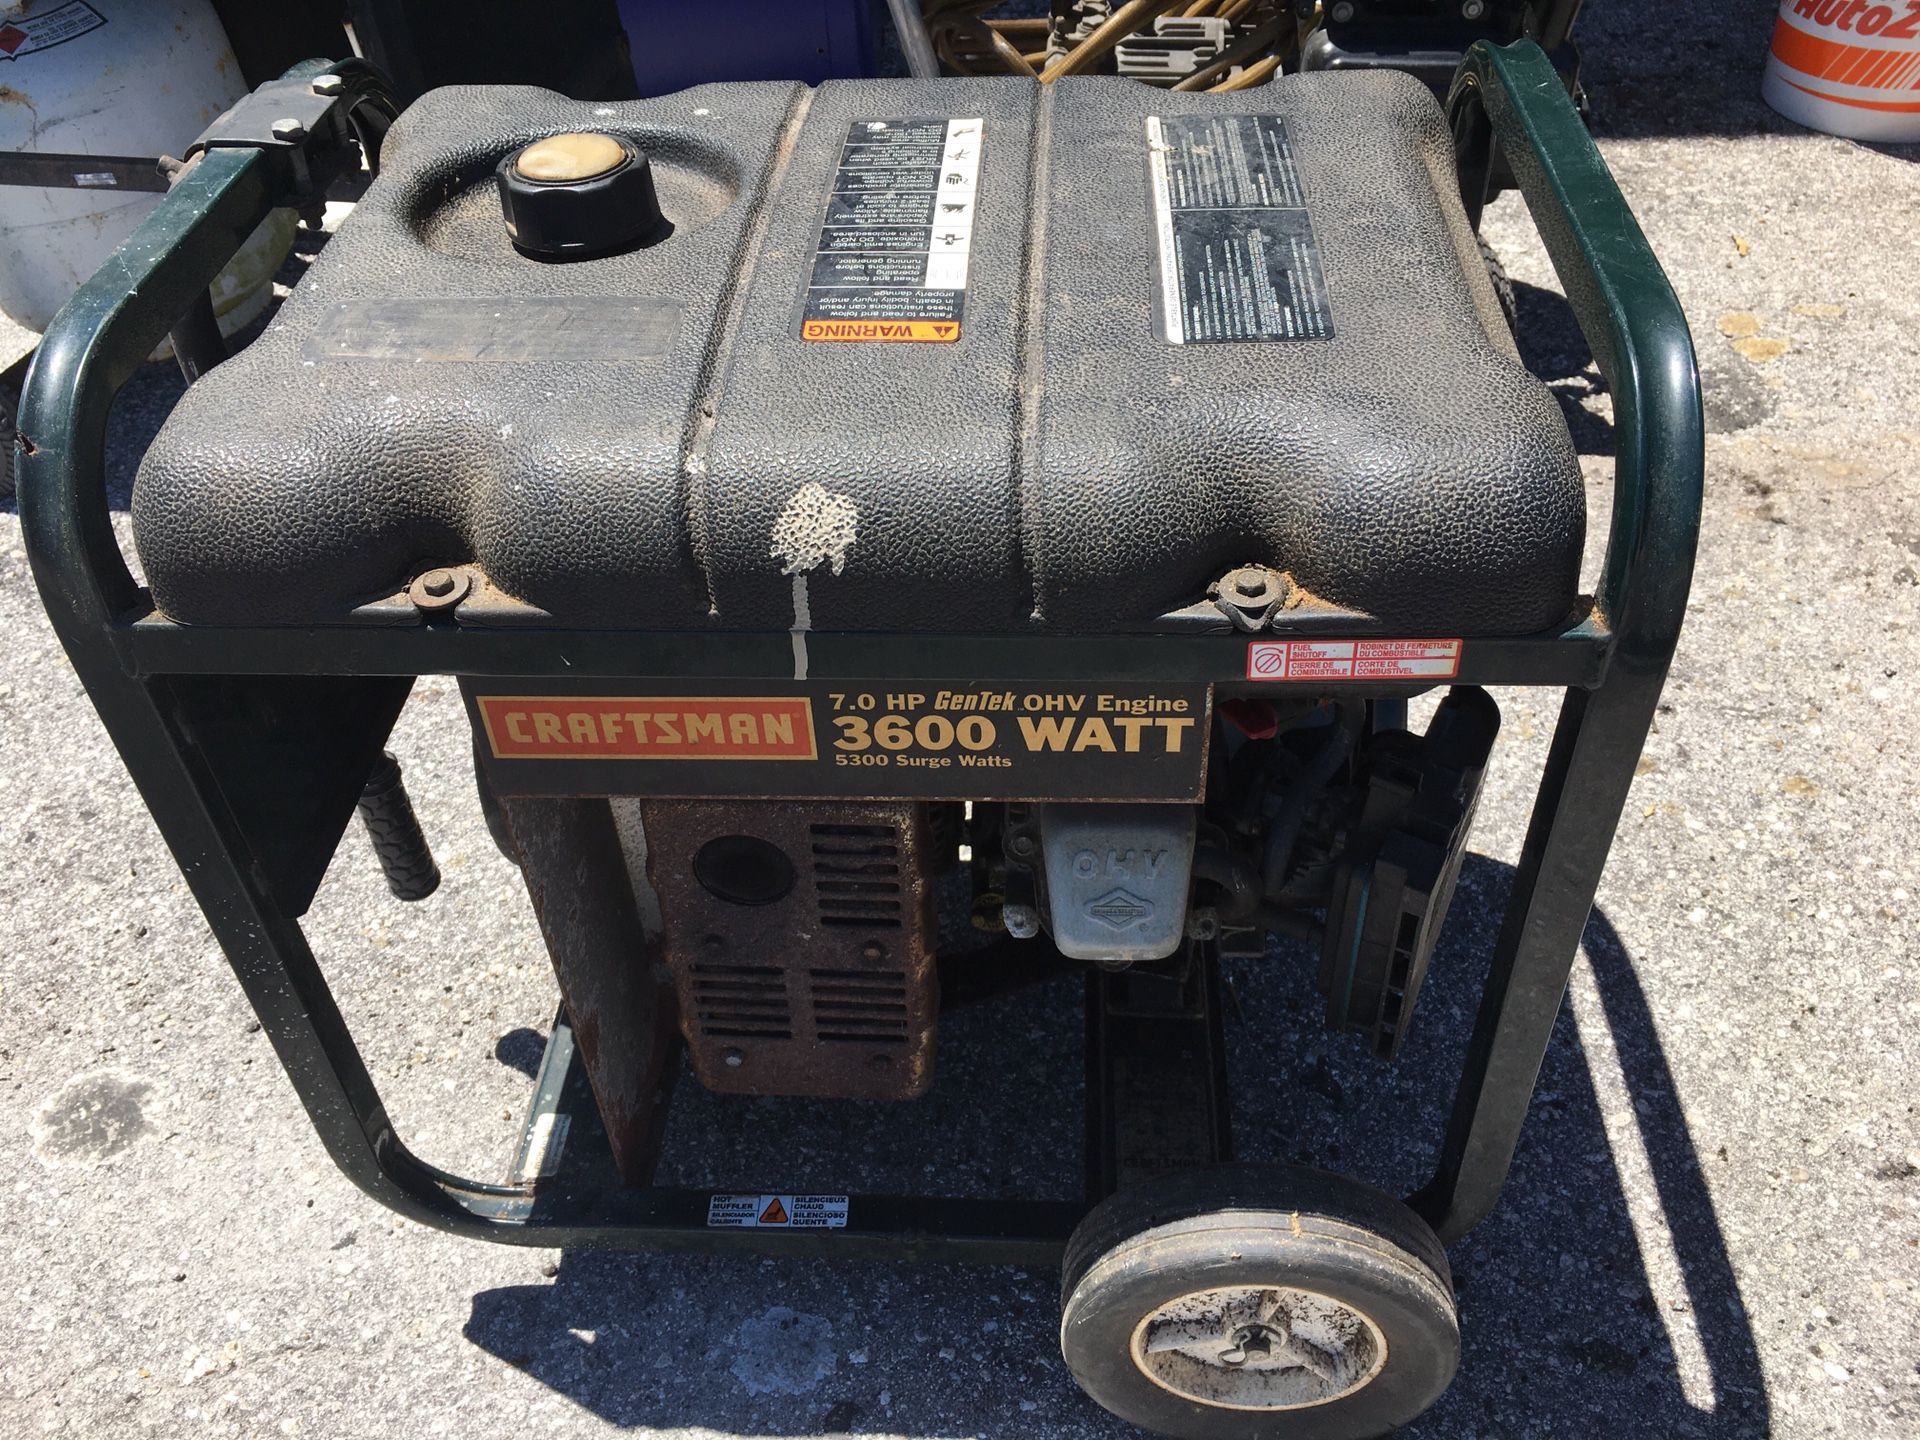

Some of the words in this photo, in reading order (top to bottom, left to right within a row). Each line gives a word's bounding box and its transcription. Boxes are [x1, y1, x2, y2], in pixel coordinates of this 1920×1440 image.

[806, 324, 913, 337] WARNING
[1291, 661, 1321, 669] CIERRE
[1323, 661, 1334, 669] DE
[1291, 668, 1348, 676] COMBUSTIBLE
[829, 693, 876, 711] 7.0
[886, 693, 926, 711] HP
[934, 691, 1017, 711] GenTek
[1023, 694, 1087, 712] OHV
[1097, 695, 1189, 715] Engine
[505, 712, 795, 744] CRAFTSMAN
[832, 715, 997, 751] 3600
[1016, 717, 1195, 753] WATT
[835, 755, 889, 767] 5300
[896, 755, 951, 769] Surge
[959, 755, 1012, 767] Watts
[1072, 849, 1168, 880] OHV
